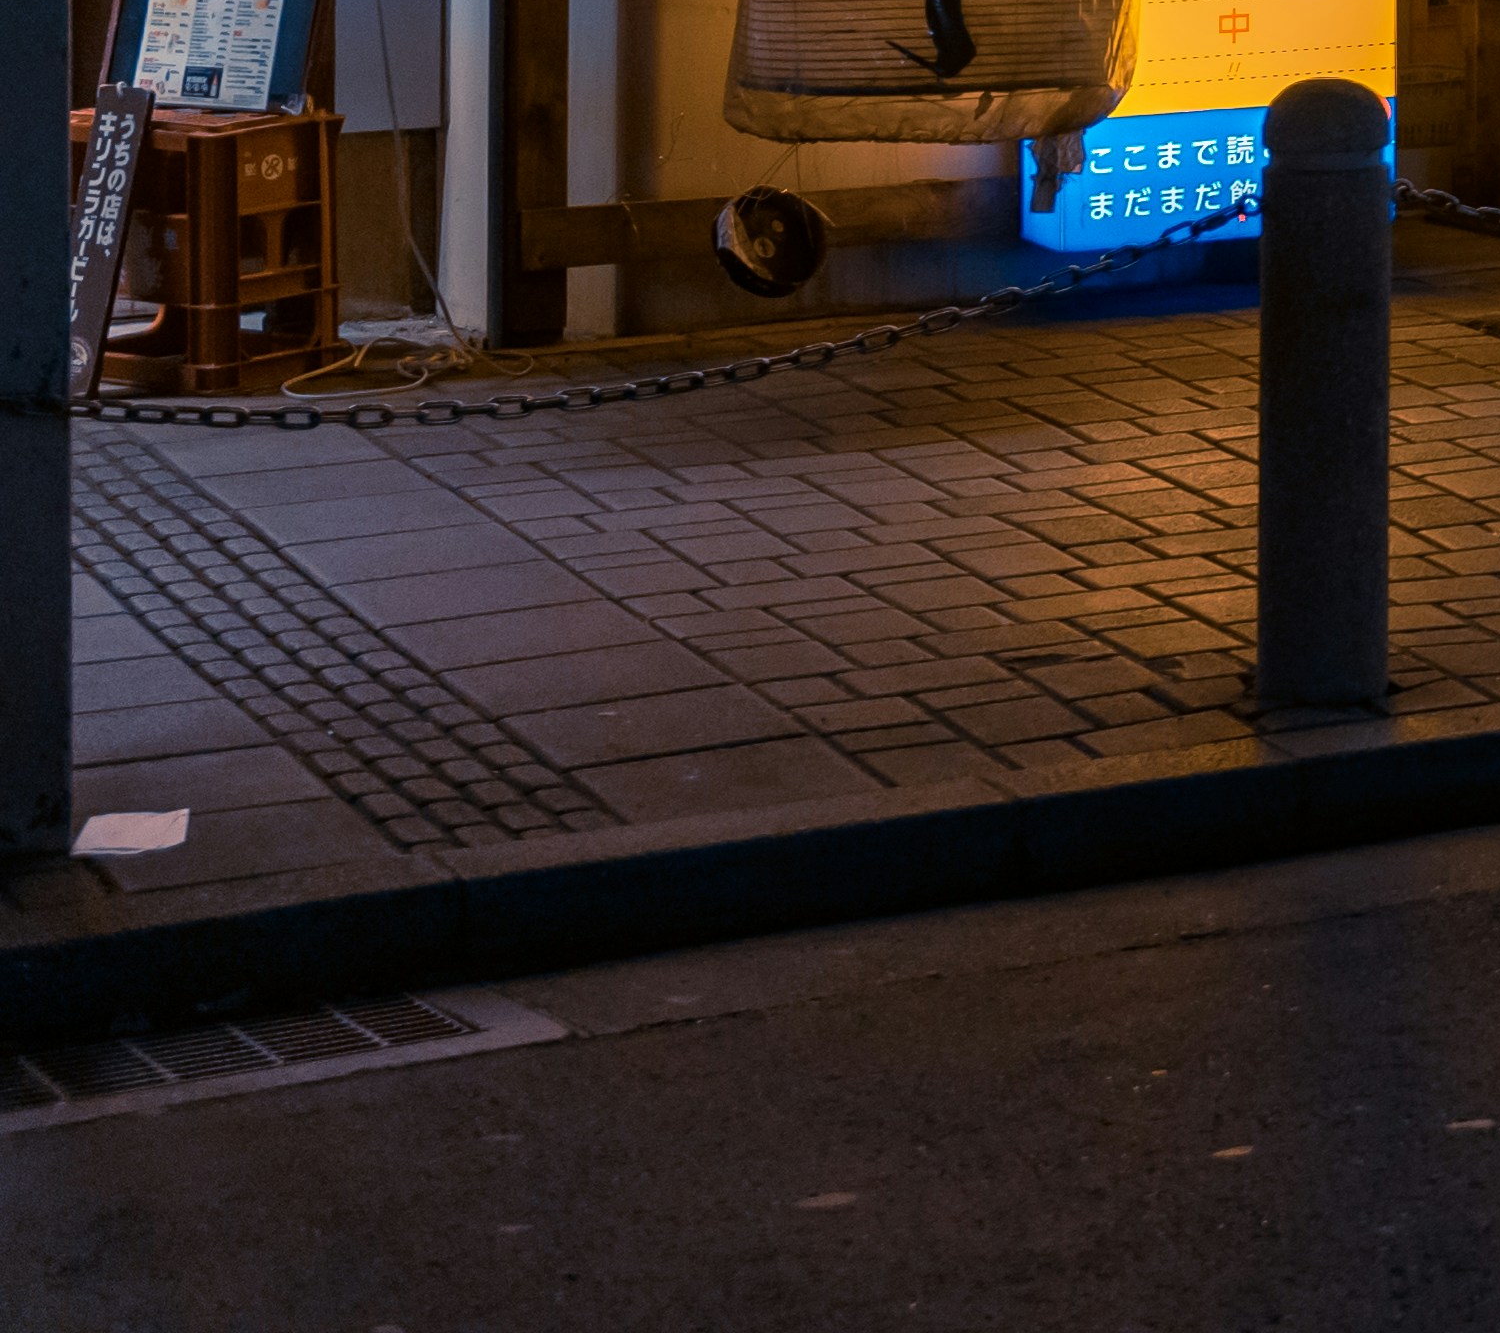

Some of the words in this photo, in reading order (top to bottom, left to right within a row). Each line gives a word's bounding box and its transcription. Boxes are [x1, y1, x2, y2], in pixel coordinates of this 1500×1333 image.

[95, 113, 137, 259] うちの店は、
[1088, 132, 1262, 177] ここまで読
